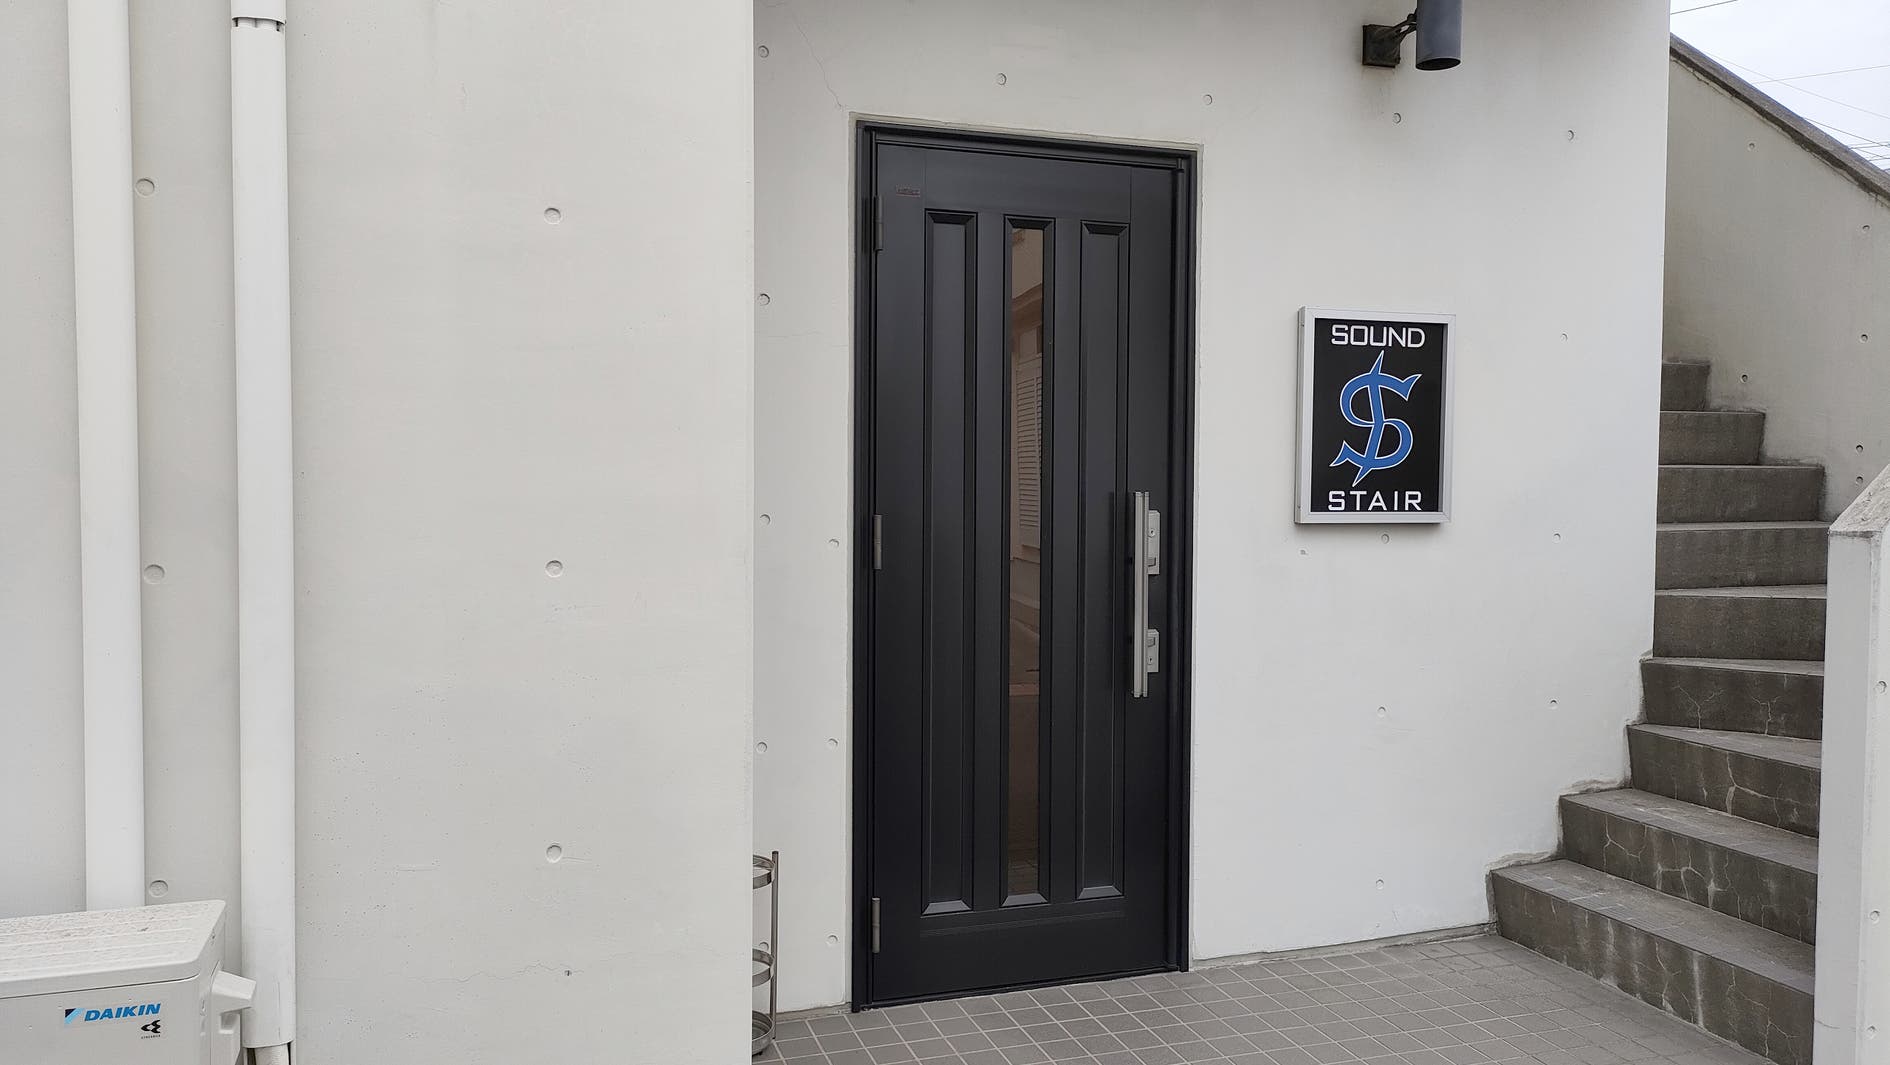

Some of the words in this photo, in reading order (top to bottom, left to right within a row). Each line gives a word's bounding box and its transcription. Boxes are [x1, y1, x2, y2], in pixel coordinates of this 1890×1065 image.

[1331, 325, 1425, 347] SOUND
[1328, 490, 1422, 511] STAIR
[84, 1003, 161, 1022] DAIKIN
